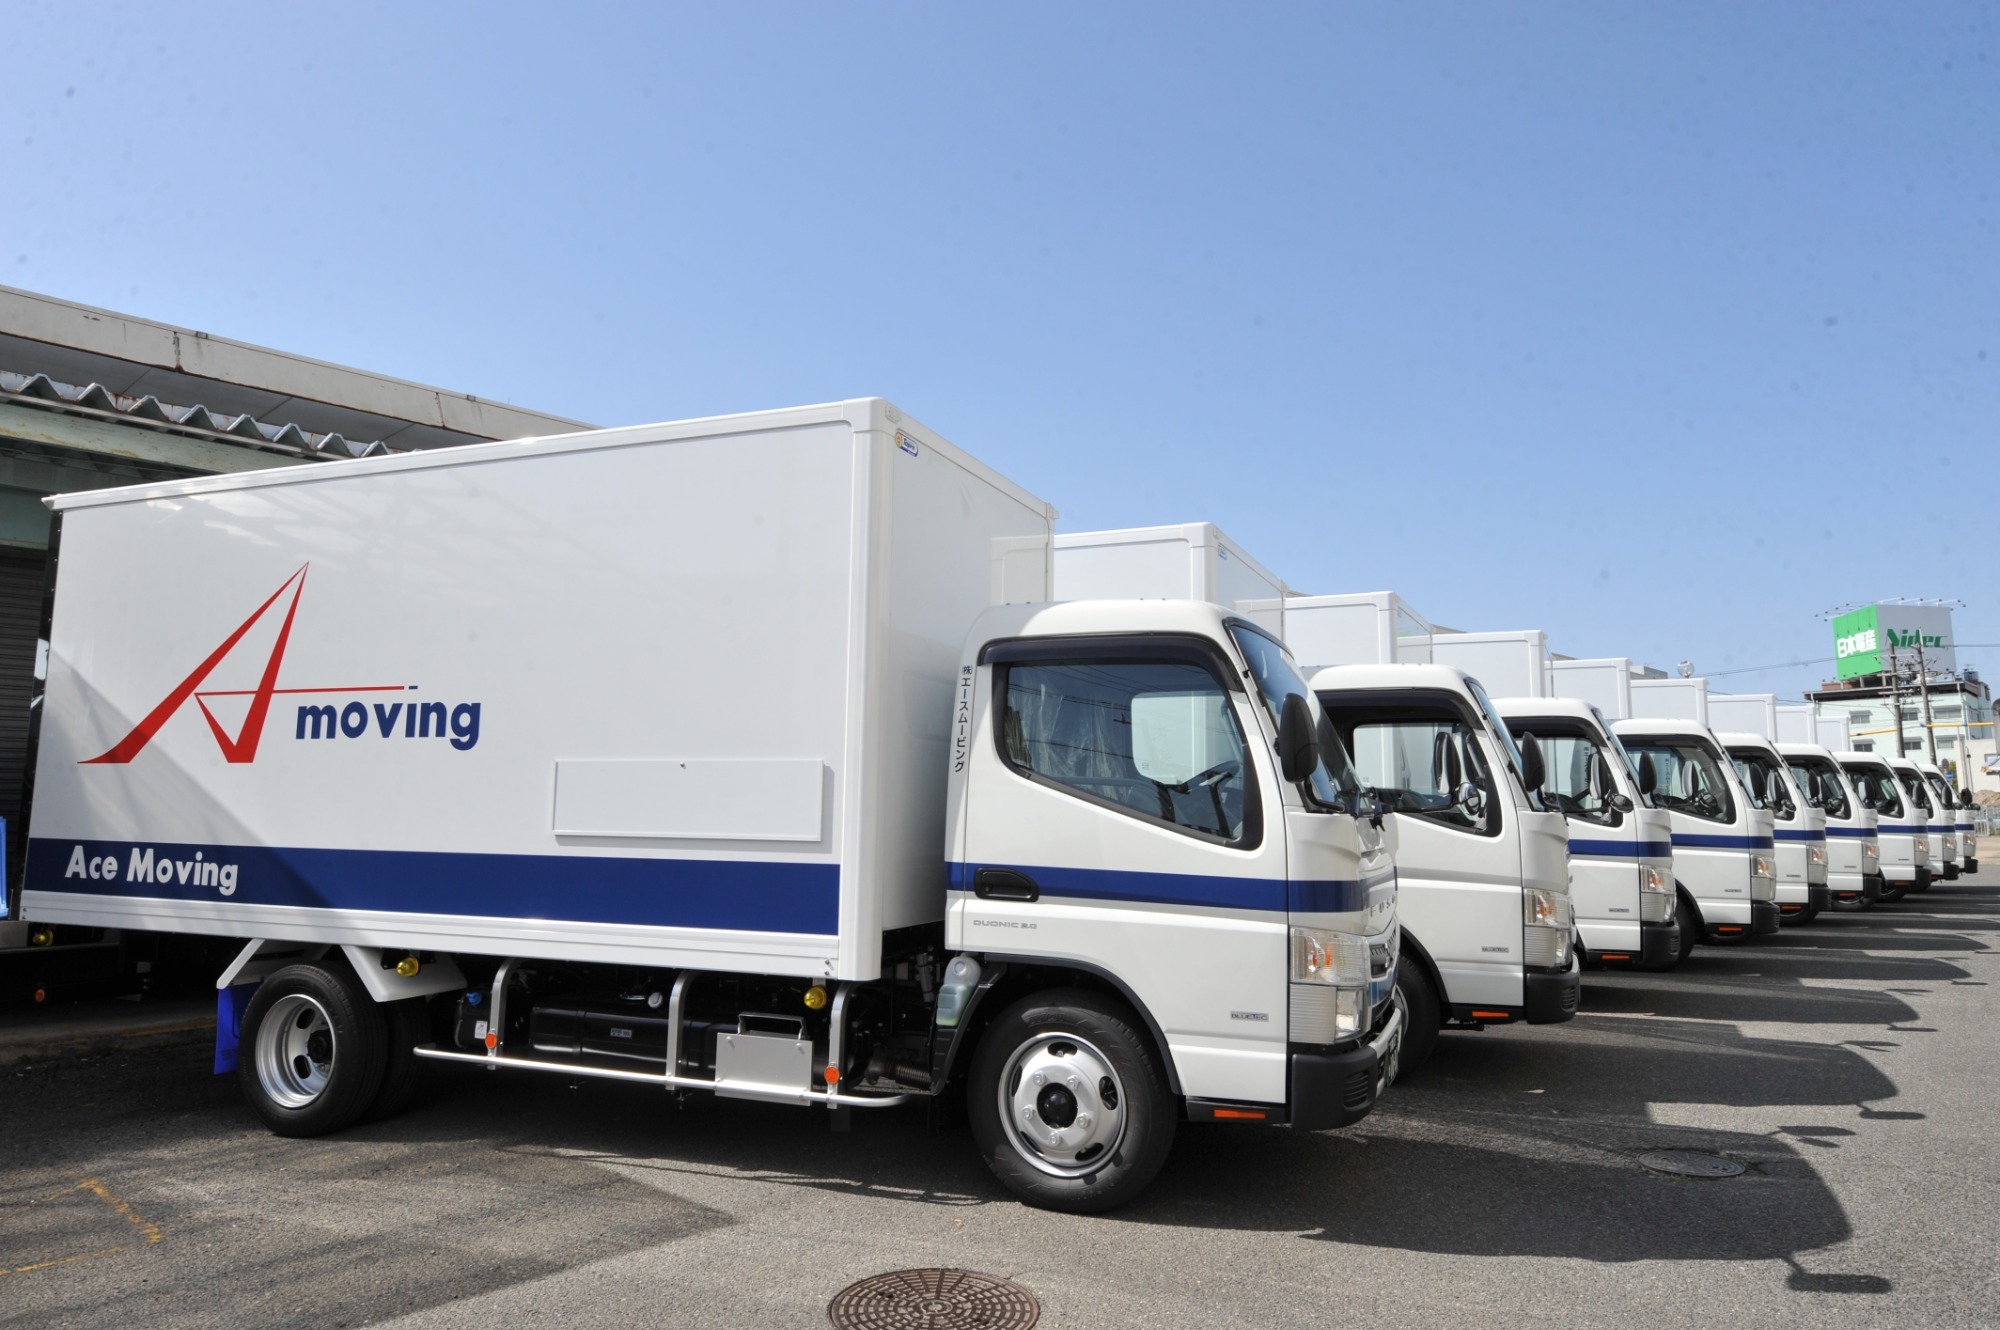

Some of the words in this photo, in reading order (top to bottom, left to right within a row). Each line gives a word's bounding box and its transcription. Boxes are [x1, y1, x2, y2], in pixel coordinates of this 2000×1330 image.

[1837, 629, 1877, 658] 日本電産
[295, 685, 481, 751] moving
[64, 845, 118, 880] Ace
[126, 847, 239, 896] Moving
[973, 919, 1019, 928] DUONIC
